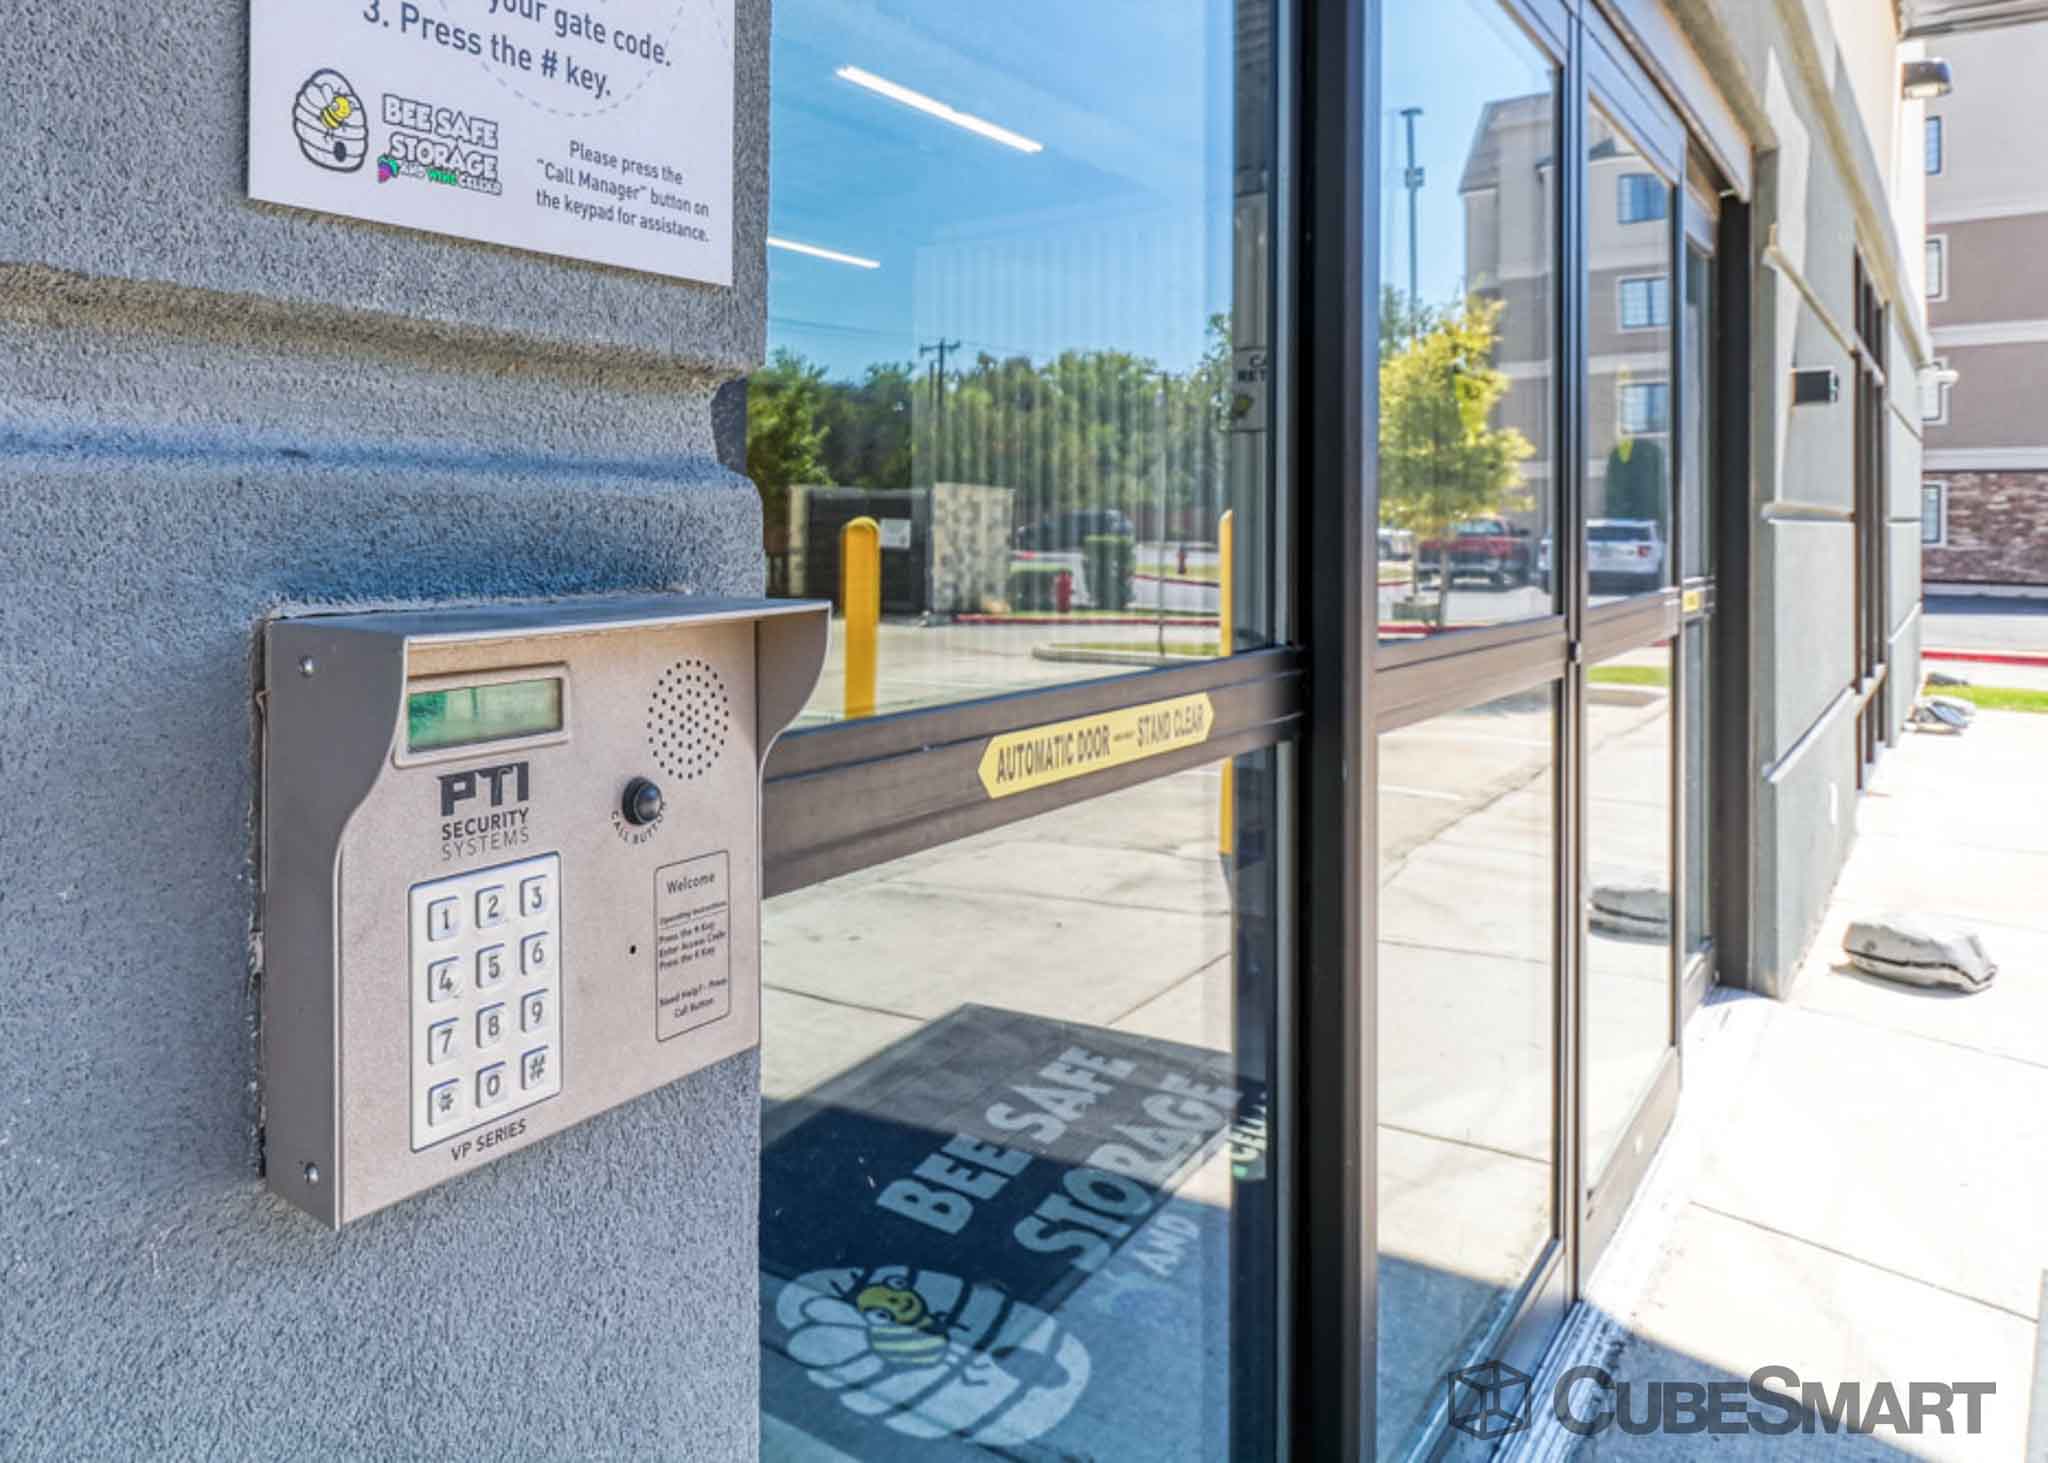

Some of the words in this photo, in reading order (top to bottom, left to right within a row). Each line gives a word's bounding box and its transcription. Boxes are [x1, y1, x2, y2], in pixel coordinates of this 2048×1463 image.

[363, 0, 389, 27] 3.
[400, 2, 482, 55] Press
[491, 34, 532, 71] the
[541, 49, 558, 79] #
[567, 56, 611, 99] key.
[554, 8, 606, 43] gate
[613, 27, 672, 67] code.
[382, 93, 433, 134] BEE
[434, 107, 498, 149] SAFE
[390, 131, 498, 182] STORAGE
[569, 139, 617, 168] Please
[621, 158, 659, 179] press
[662, 166, 683, 185] the
[536, 188, 560, 209] the
[564, 194, 614, 222] keypad
[617, 206, 637, 226] for
[639, 215, 710, 243] assistance.
[650, 187, 691, 214] button
[694, 202, 709, 217] on
[996, 734, 1074, 784] AUTOMATIC
[1077, 725, 1111, 764] DOOR
[1137, 712, 1171, 748] STAND
[1174, 704, 1205, 738] CLEAR
[437, 762, 530, 817] PTI
[441, 807, 530, 841] SECURITY
[441, 827, 530, 862] SYSTEMS
[441, 907, 450, 931] 1
[487, 893, 500, 919] 2
[531, 885, 543, 910] 3
[666, 873, 716, 894] Welcome
[438, 967, 454, 992] 4
[487, 954, 501, 980] 5
[531, 939, 545, 965] 6
[439, 1027, 453, 1055] 7
[487, 1014, 500, 1038] 8
[531, 999, 544, 1026] 9
[529, 1053, 545, 1081] #
[451, 1141, 472, 1161] VP
[475, 1118, 527, 1153] SERIES
[876, 1133, 1034, 1236] BEE
[985, 1045, 1136, 1145] SAFE
[1013, 1072, 1243, 1273] STORAGE
[1133, 1214, 1199, 1277] AND
